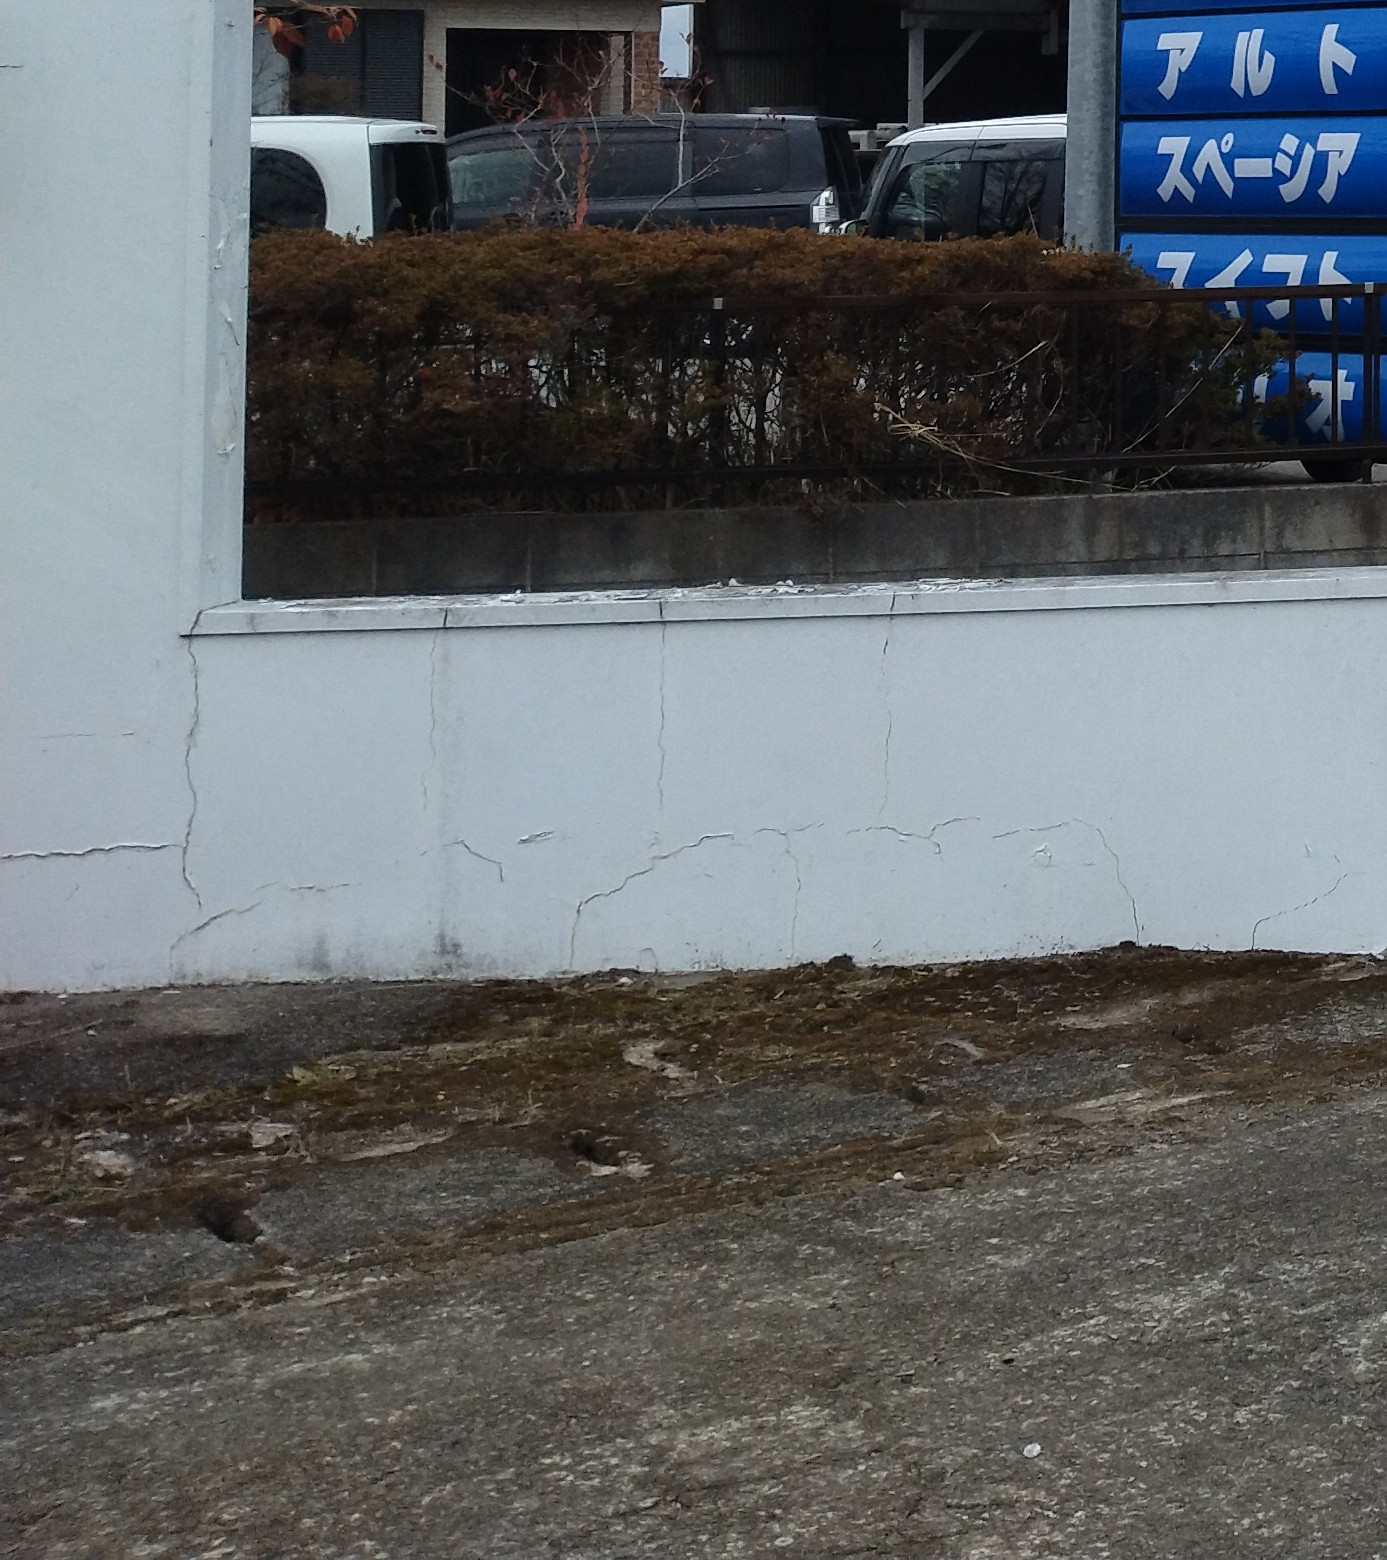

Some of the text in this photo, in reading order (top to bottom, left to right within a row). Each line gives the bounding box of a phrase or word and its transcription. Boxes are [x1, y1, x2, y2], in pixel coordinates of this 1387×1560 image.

[1156, 23, 1357, 100] アルト
[1156, 131, 1361, 205] スペーシア
